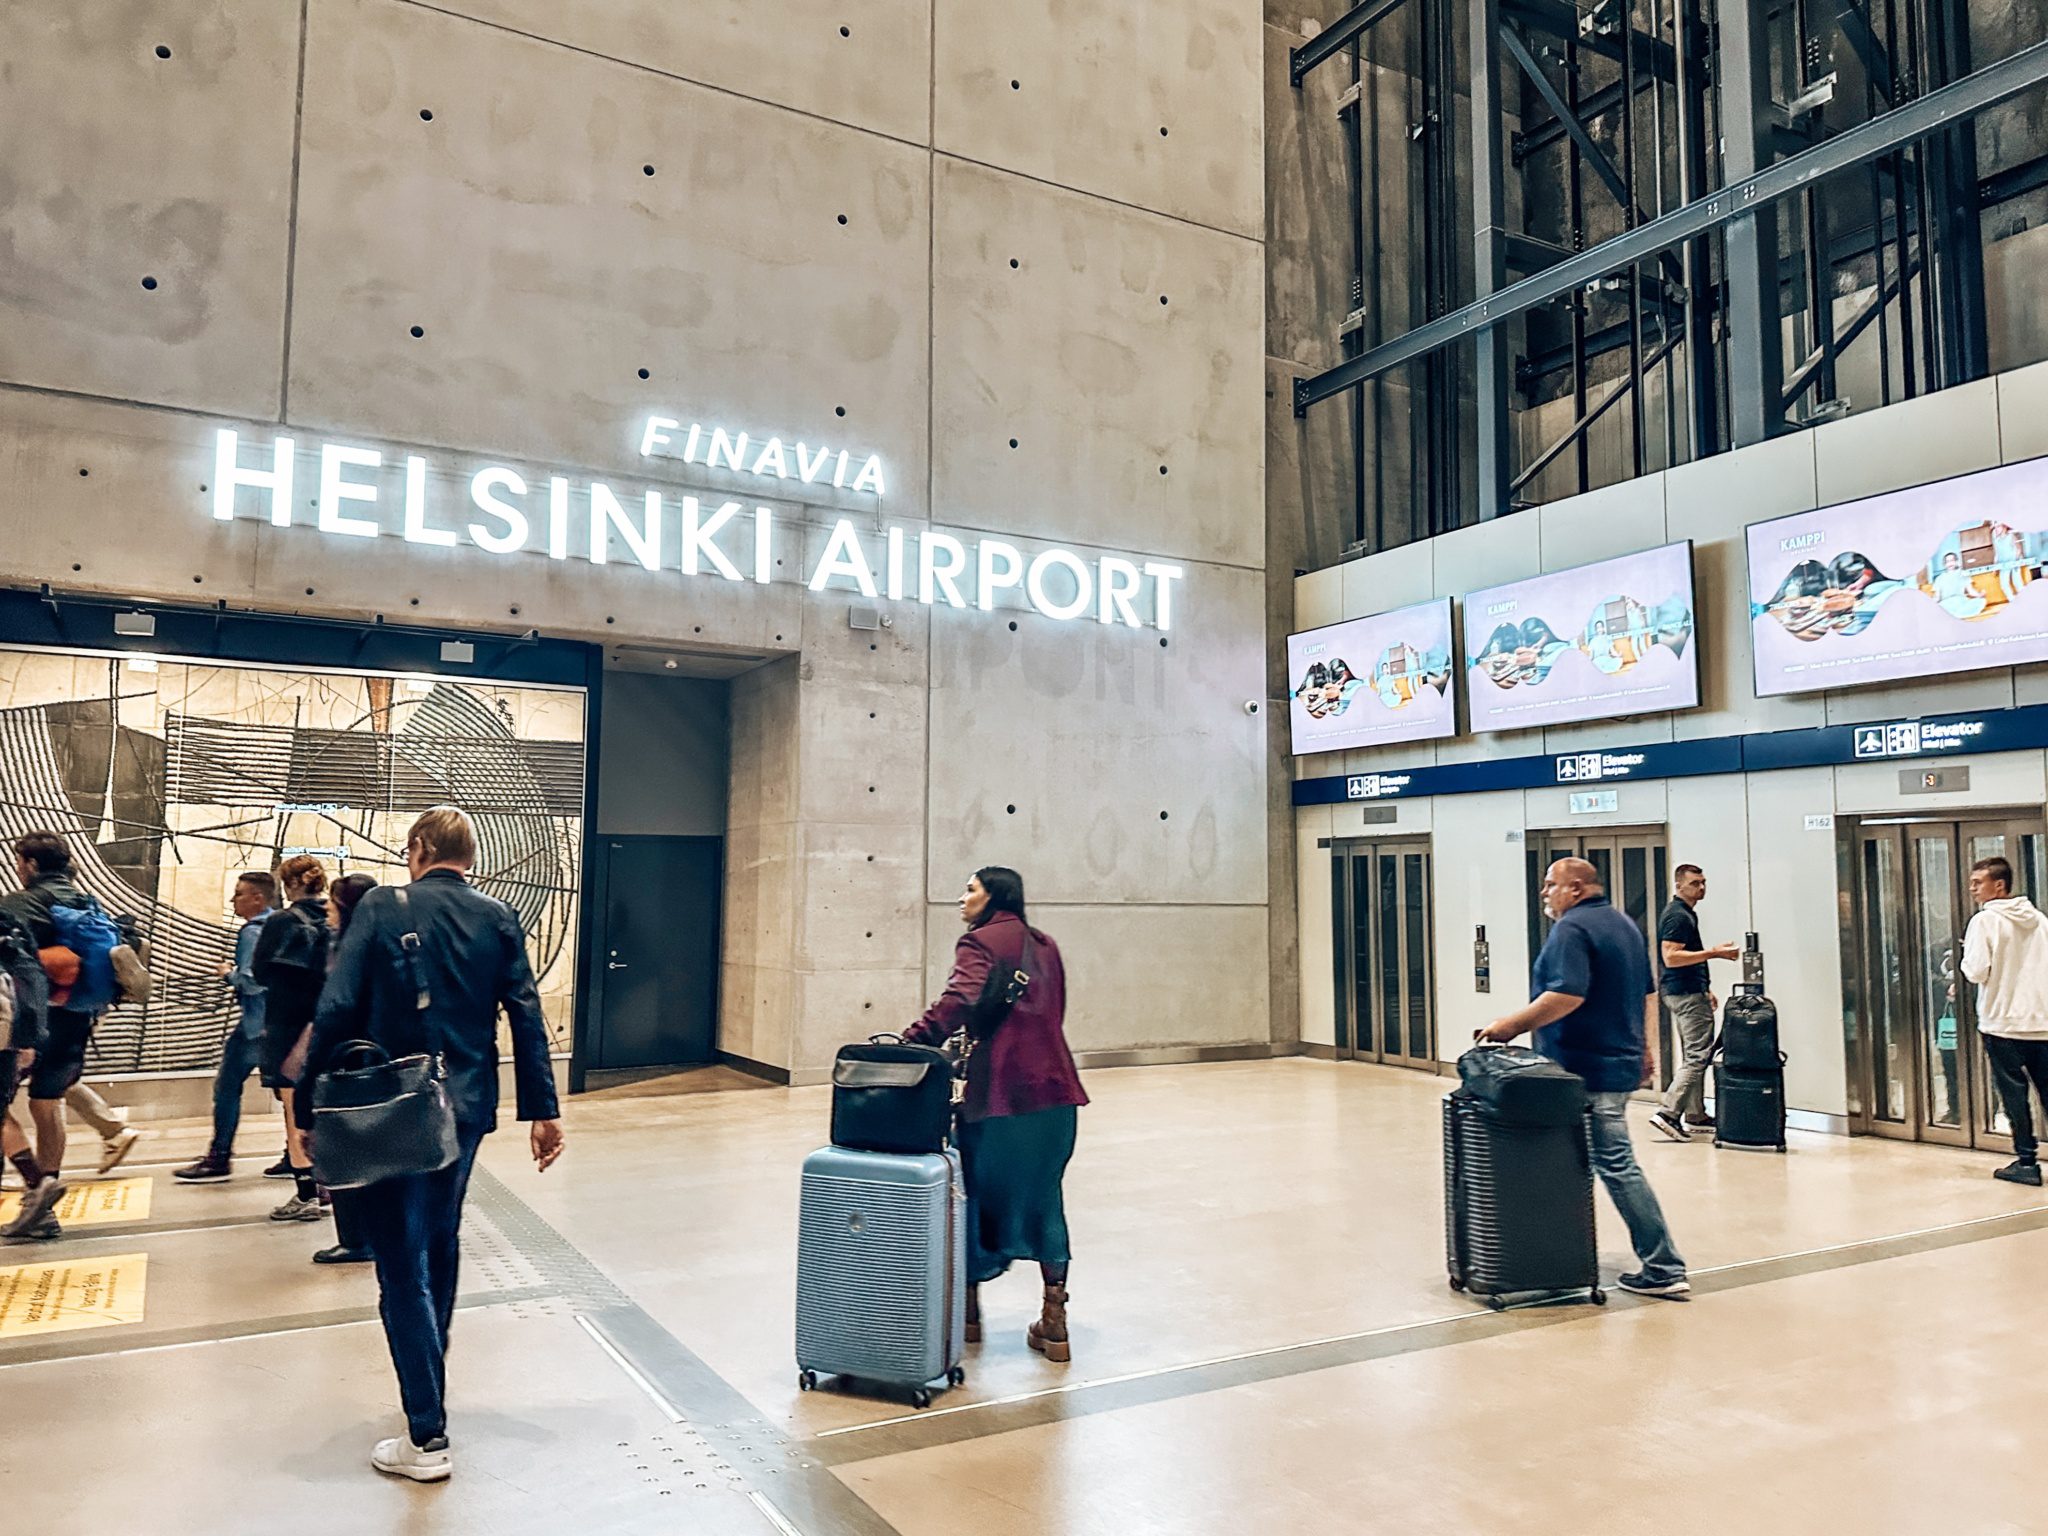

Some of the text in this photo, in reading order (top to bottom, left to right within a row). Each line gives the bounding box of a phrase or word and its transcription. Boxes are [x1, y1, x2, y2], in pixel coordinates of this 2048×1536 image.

[640, 417, 886, 495] FINAVIA
[212, 428, 1184, 630] HELSINKI AIRPORT
[1780, 531, 1825, 552] KAMPPI
[1921, 721, 1984, 739] Elevator
